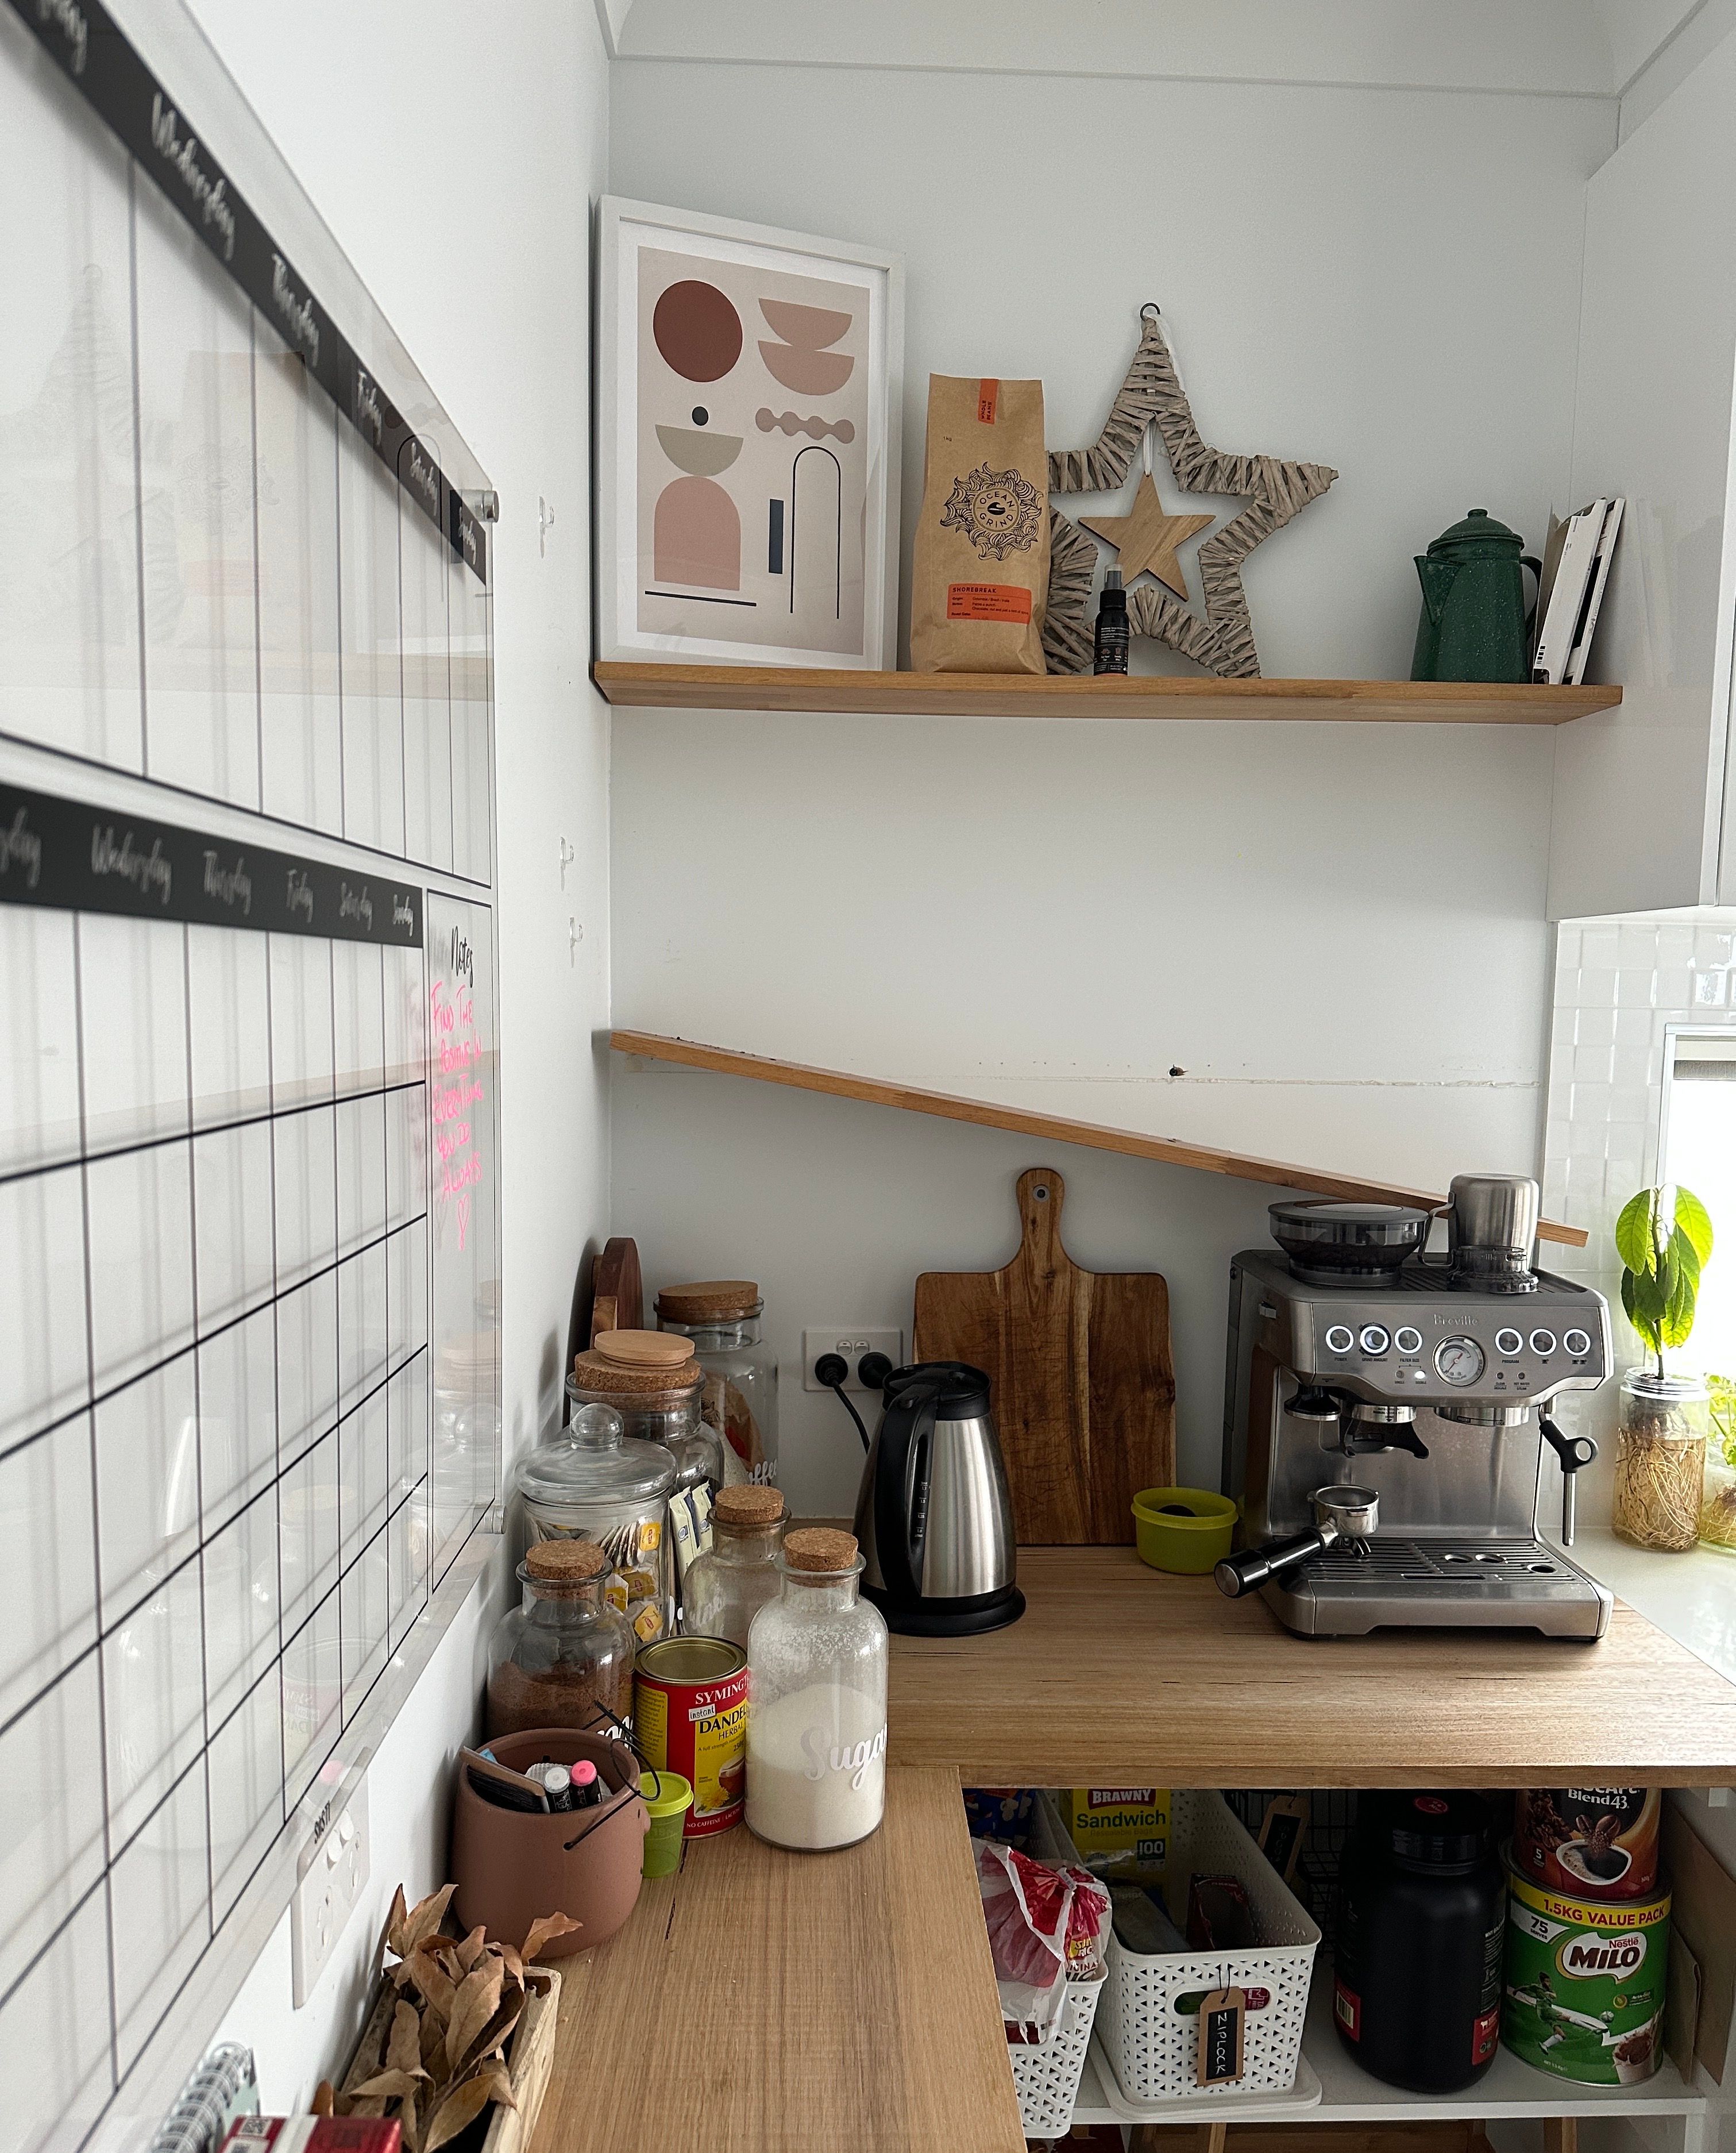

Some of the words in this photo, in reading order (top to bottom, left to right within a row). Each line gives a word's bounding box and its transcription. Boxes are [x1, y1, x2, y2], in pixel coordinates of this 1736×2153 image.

[979, 491, 1015, 509] OCEAN
[979, 513, 1014, 528] GRIND
[452, 926, 473, 988] Notes
[1433, 1314, 1479, 1326] Breville
[695, 1674, 747, 1705] SYMINGT
[690, 1705, 715, 1719] instant
[699, 1703, 746, 1734] DANDEL
[718, 1721, 743, 1741] HERBAL
[800, 1722, 888, 1791] Suga
[1092, 1789, 1151, 1804] BRAWNY
[1568, 1788, 1610, 1805] Blend
[1610, 1795, 1628, 1809] 43
[1076, 1809, 1166, 1829] Sandwich
[1139, 1840, 1164, 1855] 100
[1536, 1848, 1542, 1859] 5
[1544, 1898, 1583, 1921] 1.5KG
[1587, 1911, 1635, 1926] VALUE
[1638, 1905, 1665, 1924] PACK
[1530, 1916, 1549, 1934] 75
[1530, 1928, 1548, 1940] SERVES
[1078, 1946, 1094, 1956] RIC
[1568, 1946, 1641, 1969] MILO
[1215, 2012, 1228, 2075] ZIPLOCK
